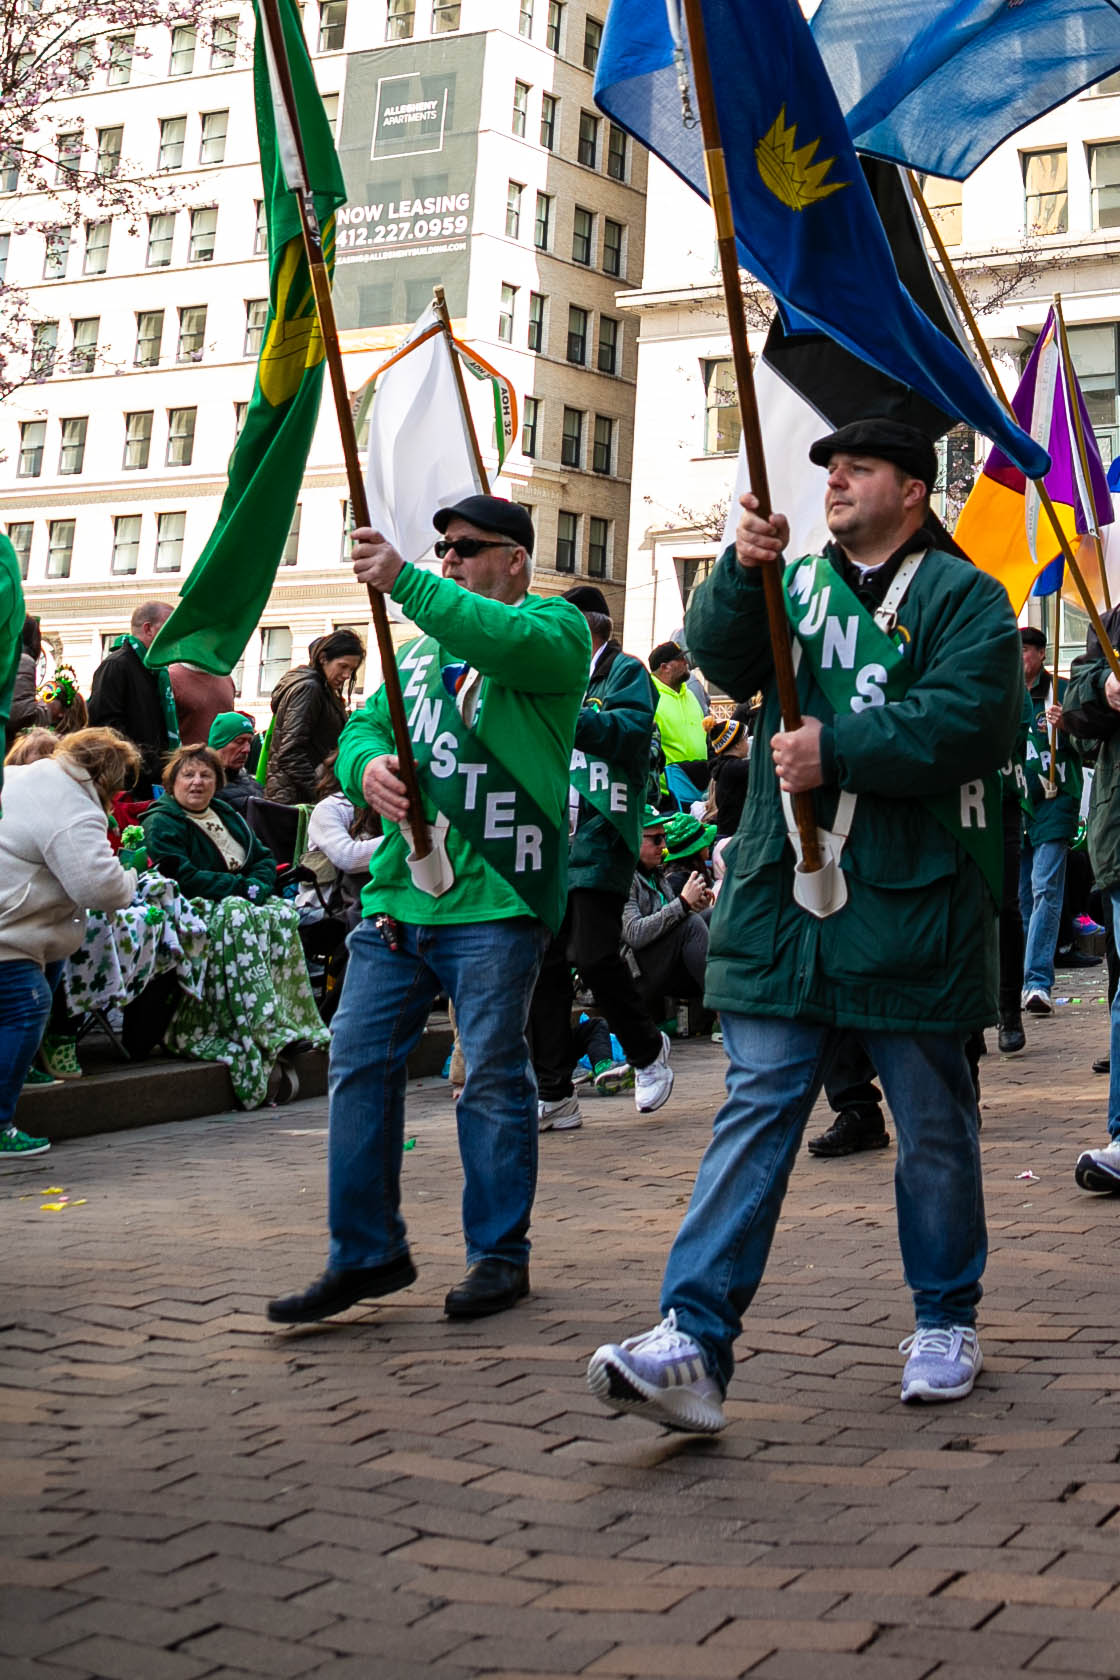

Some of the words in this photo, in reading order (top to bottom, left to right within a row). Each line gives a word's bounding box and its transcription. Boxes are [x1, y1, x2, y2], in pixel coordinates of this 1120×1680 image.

[382, 110, 438, 126] APARTMENTS
[383, 100, 438, 117] ALLEGHENY
[337, 203, 384, 225] NOW
[388, 193, 470, 219] LEASING
[335, 215, 468, 247] 412.227.0959
[501, 387, 510, 416] AOH
[504, 421, 512, 437] 32
[787, 557, 987, 829] MUNSR
[400, 636, 544, 873] LEINSTER
